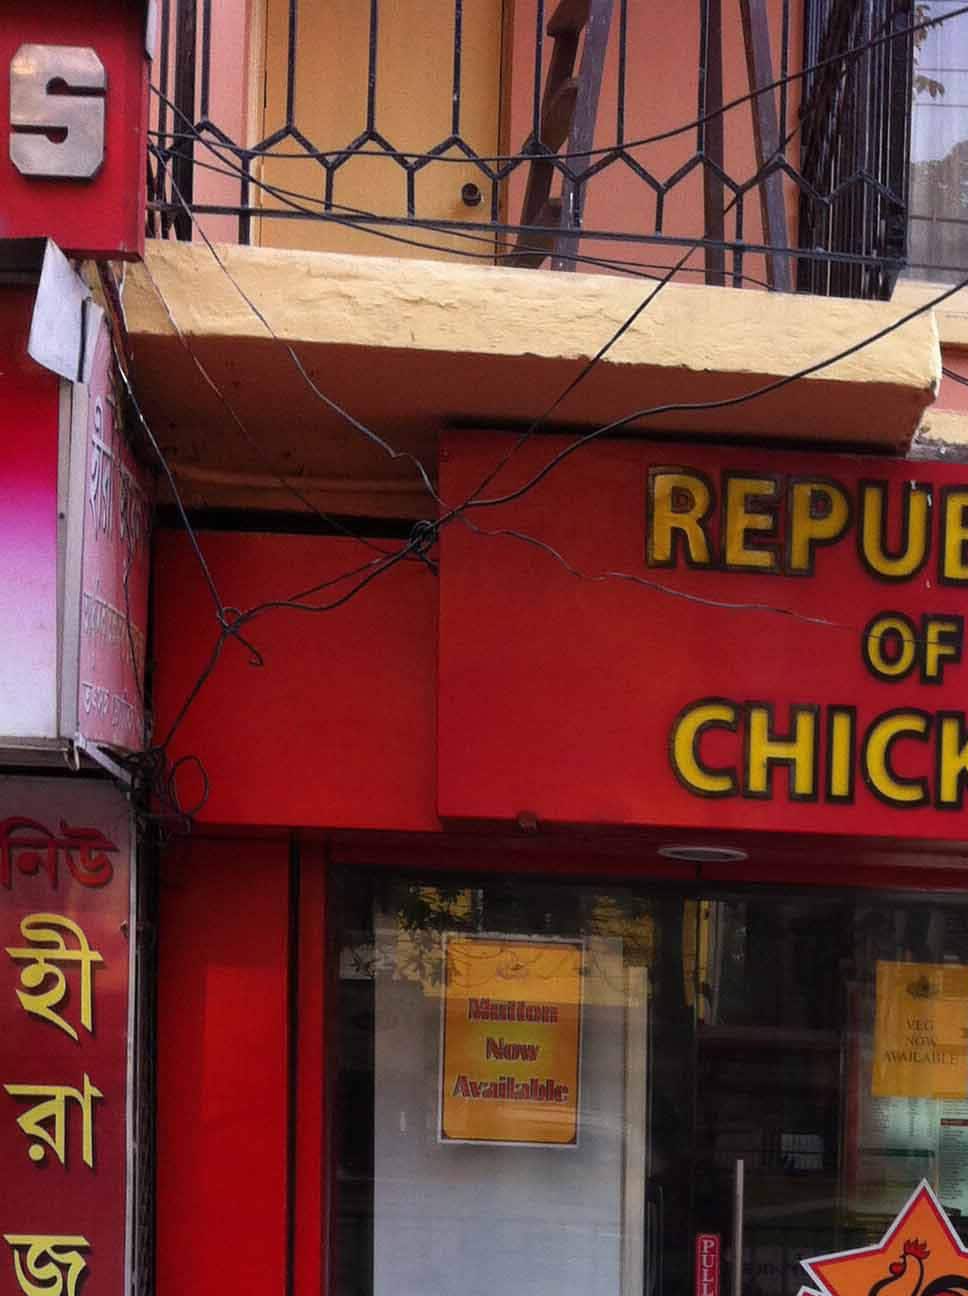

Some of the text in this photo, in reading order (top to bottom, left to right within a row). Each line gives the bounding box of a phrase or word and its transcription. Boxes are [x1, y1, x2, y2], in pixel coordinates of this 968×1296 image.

[9, 44, 107, 182] S
[861, 610, 964, 684] OF
[485, 1037, 541, 1062] Now
[453, 1075, 570, 1103] Available
[702, 1239, 715, 1296] PULL
